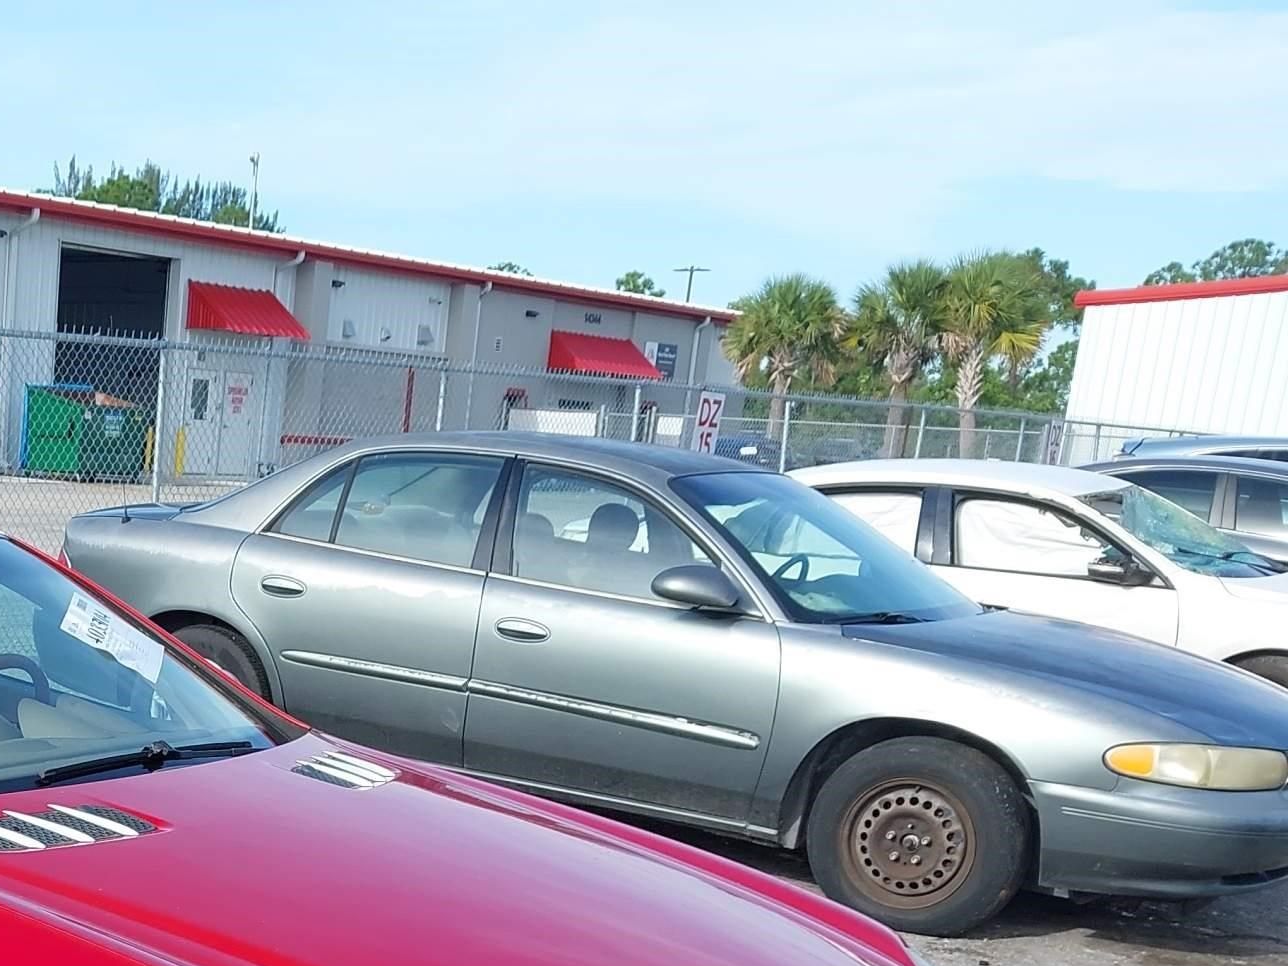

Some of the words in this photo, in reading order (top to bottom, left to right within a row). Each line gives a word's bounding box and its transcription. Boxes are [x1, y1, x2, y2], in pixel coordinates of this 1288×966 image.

[698, 398, 723, 428] DZ
[698, 431, 712, 453] 15
[1050, 424, 1062, 447] DZ
